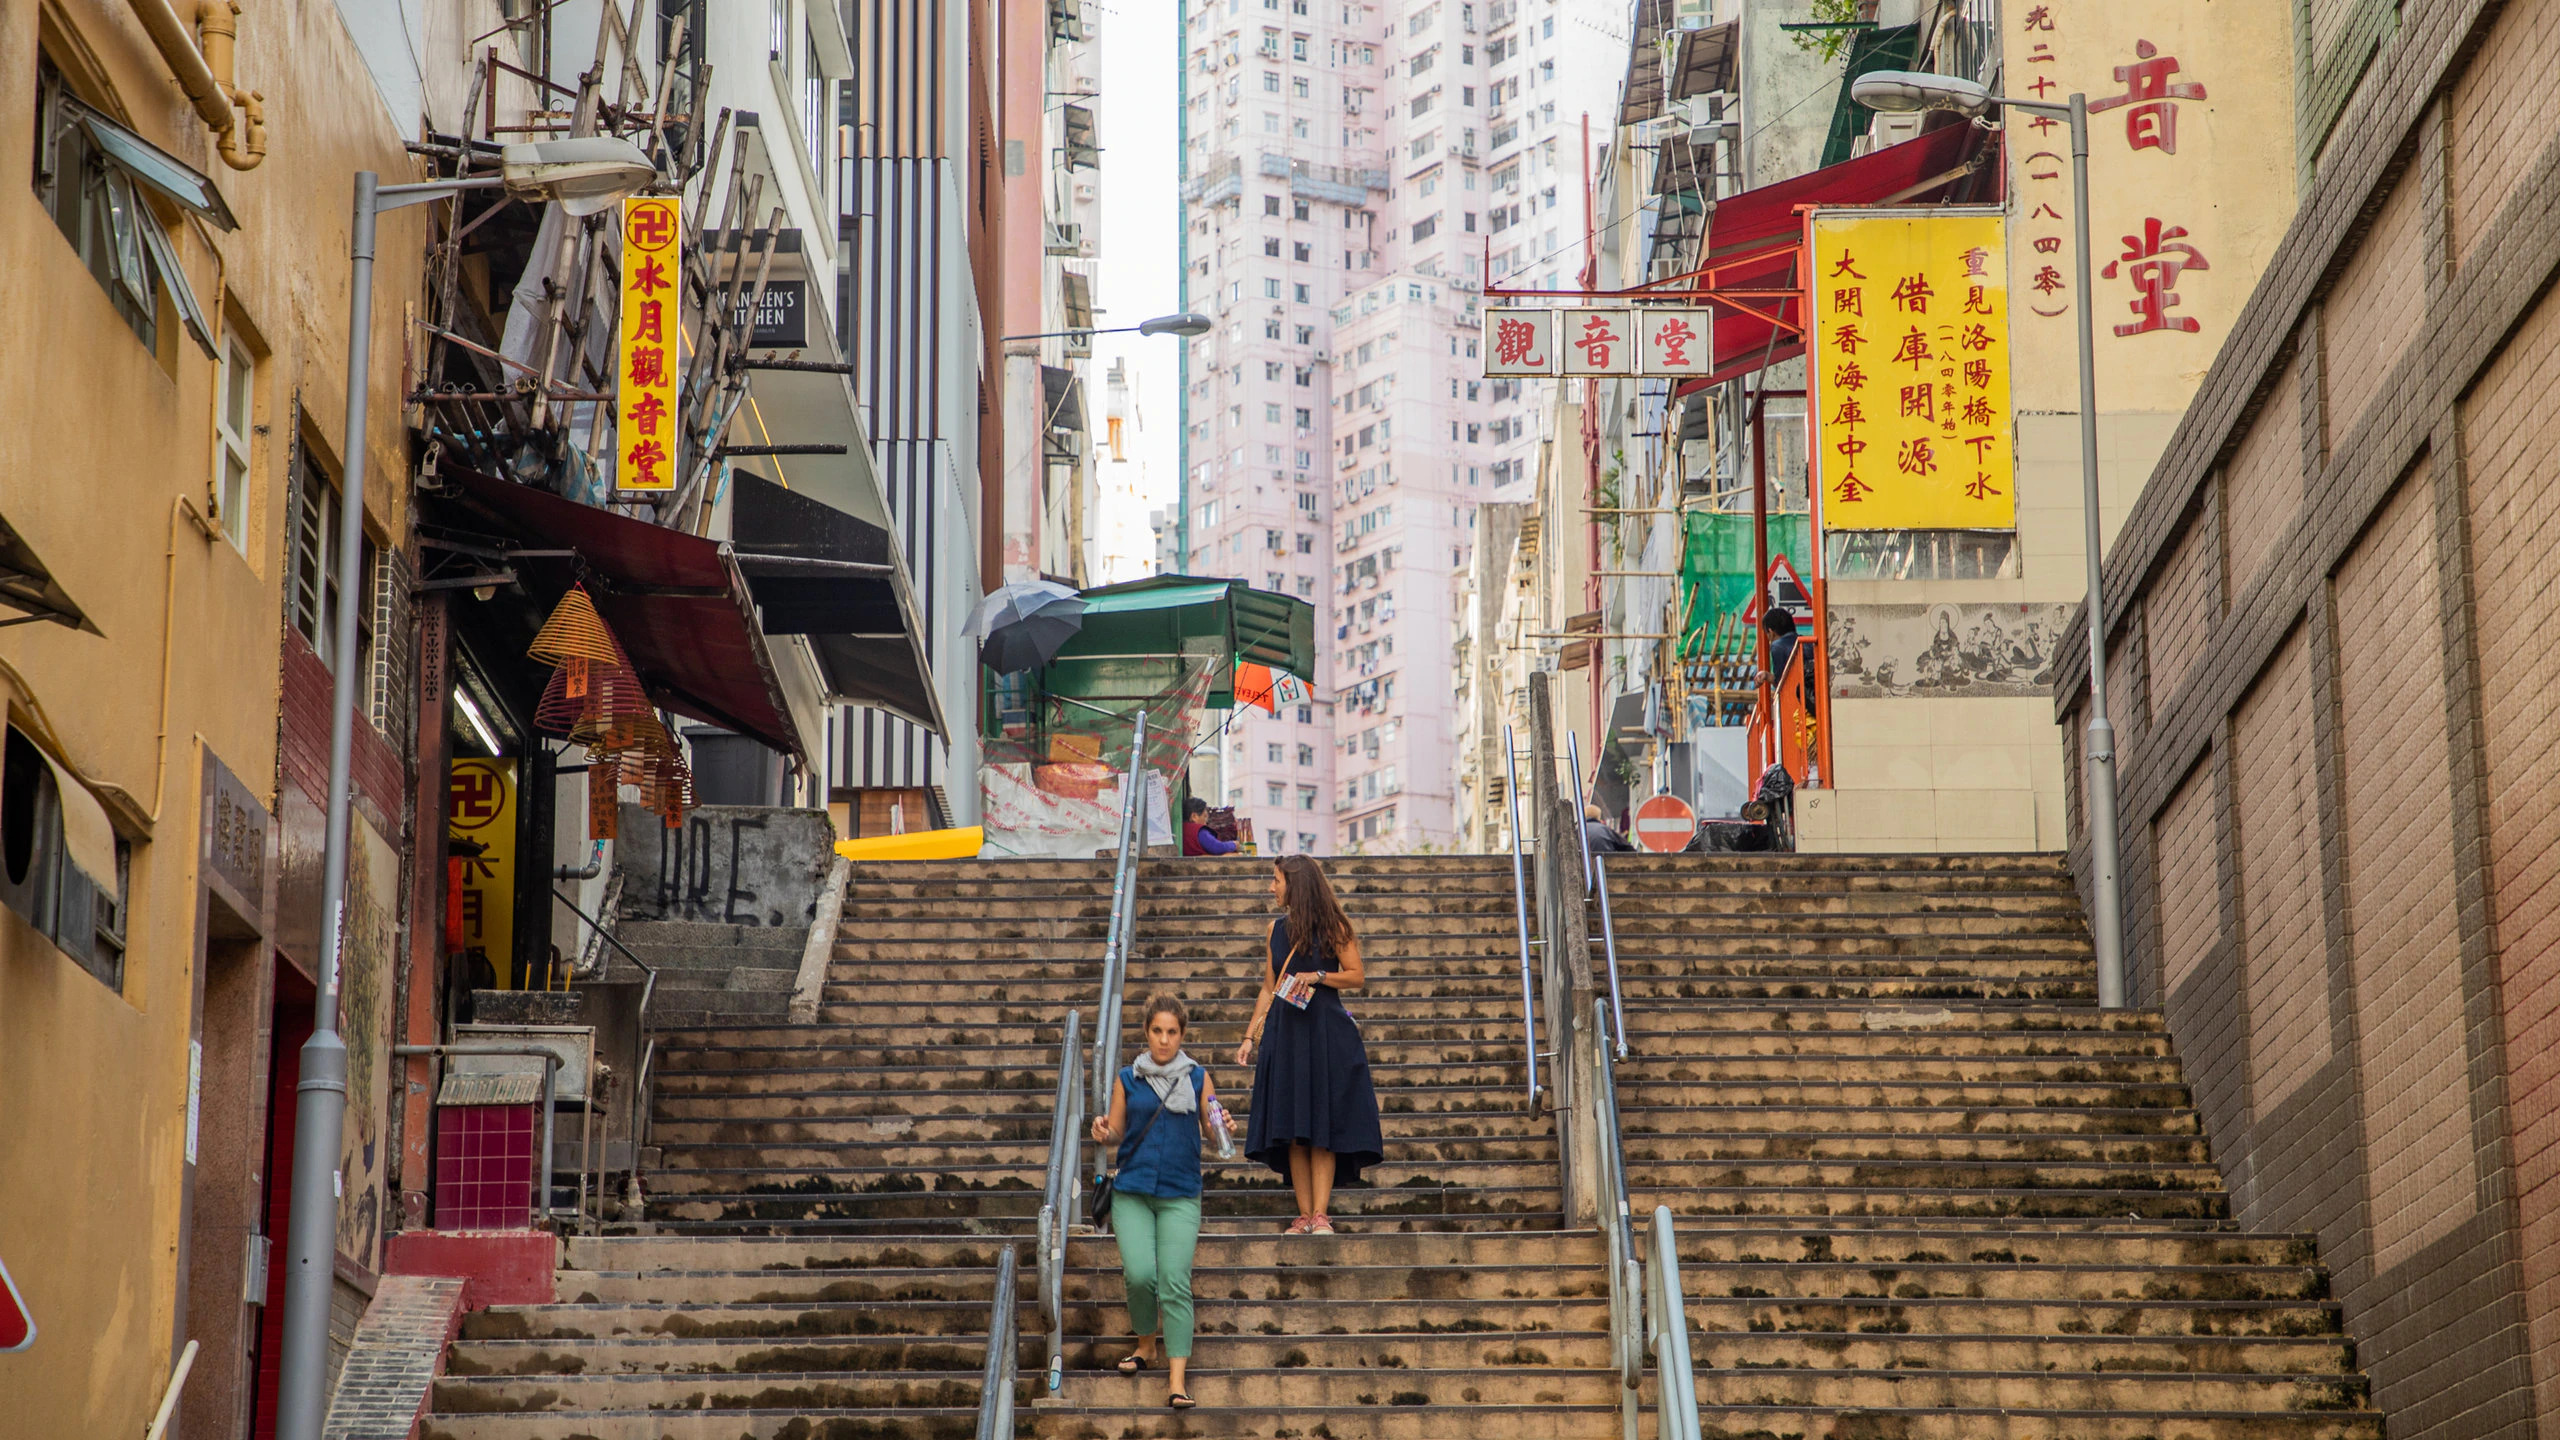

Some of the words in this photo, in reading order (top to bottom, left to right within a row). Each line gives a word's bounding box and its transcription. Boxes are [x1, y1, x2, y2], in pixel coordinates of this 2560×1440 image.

[2086, 39, 2210, 337] 音堂
[627, 255, 671, 484] 水月觀音堂
[733, 309, 784, 325] ITHEN
[1495, 315, 1697, 369] 觀音堂
[1829, 248, 1874, 503] 大開香海庫中金
[1890, 272, 1937, 477] 借庫開源
[1958, 247, 2001, 501] 重見洛陽橋下水
